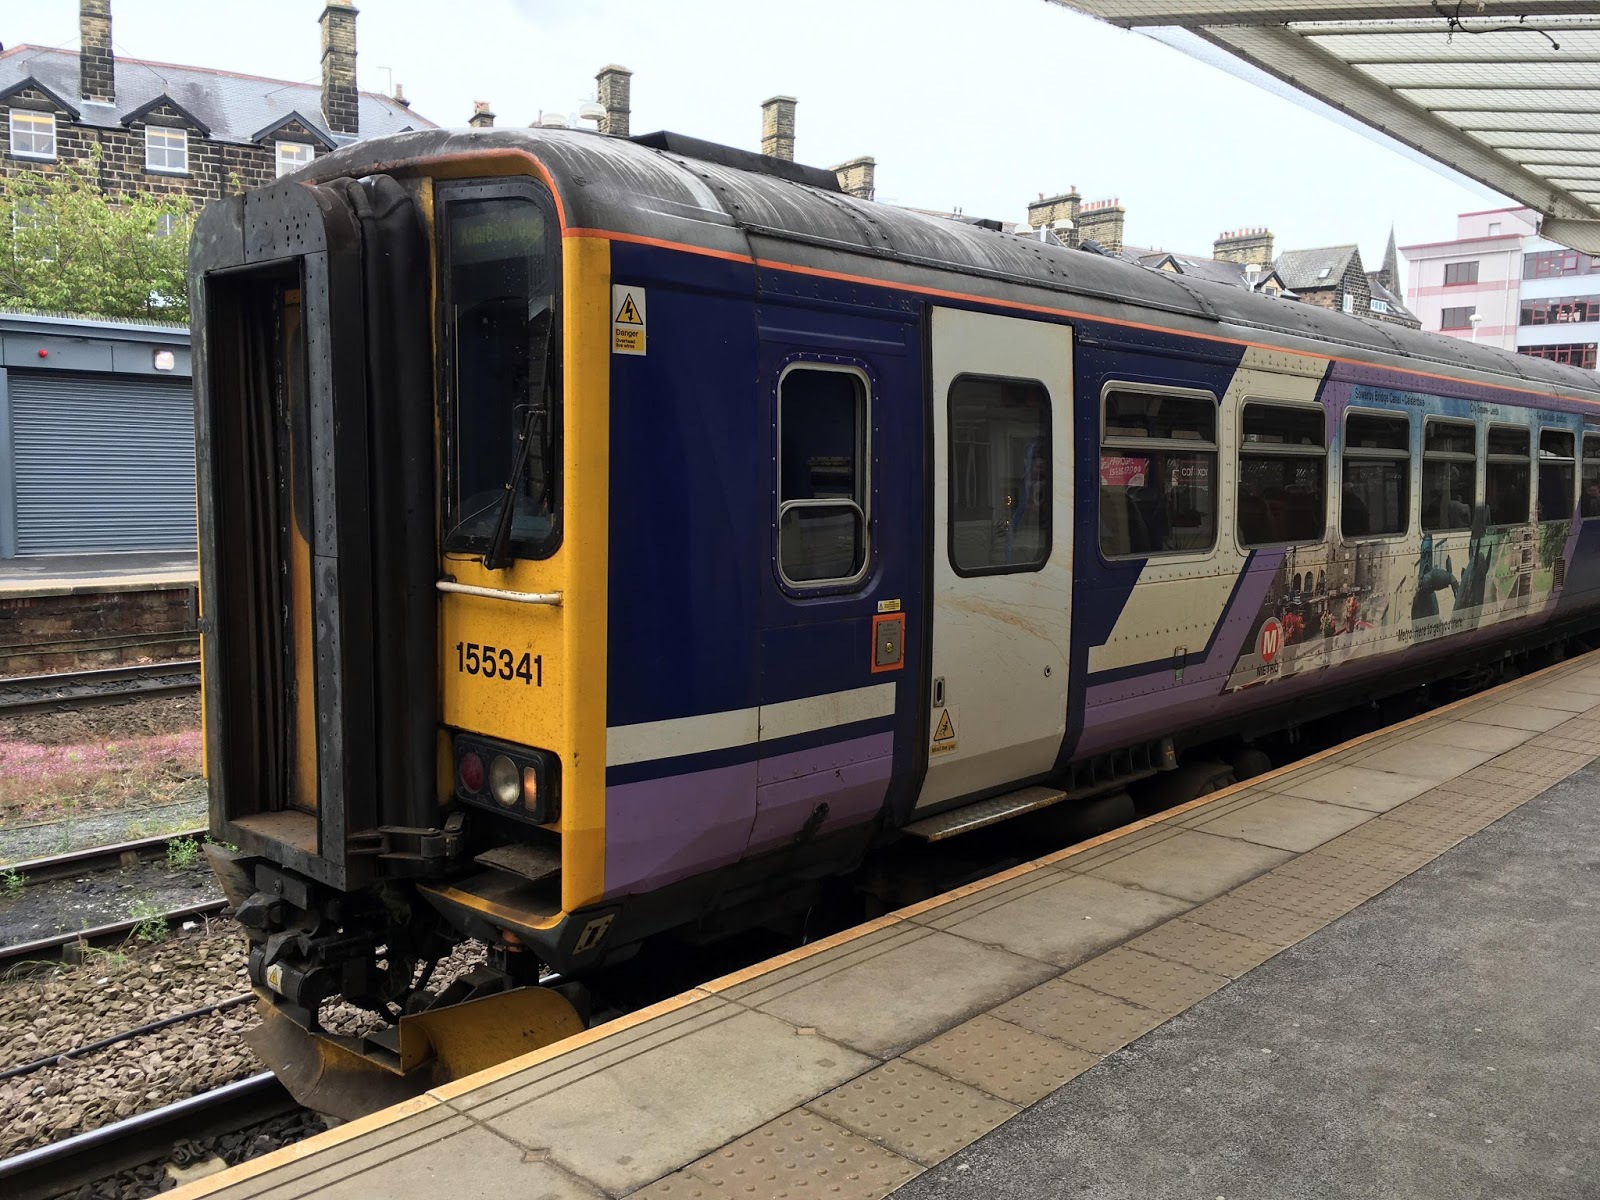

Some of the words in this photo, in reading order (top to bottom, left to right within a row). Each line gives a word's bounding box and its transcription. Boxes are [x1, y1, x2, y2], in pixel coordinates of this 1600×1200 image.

[615, 329, 639, 338] Danger
[1355, 387, 1374, 403] Sowerby
[1374, 390, 1389, 405] Bridge
[1389, 392, 1402, 404] Canal
[1427, 623, 1433, 635] to
[1262, 629, 1278, 655] M
[456, 641, 542, 687] 155341
[1256, 662, 1279, 677] METRO
